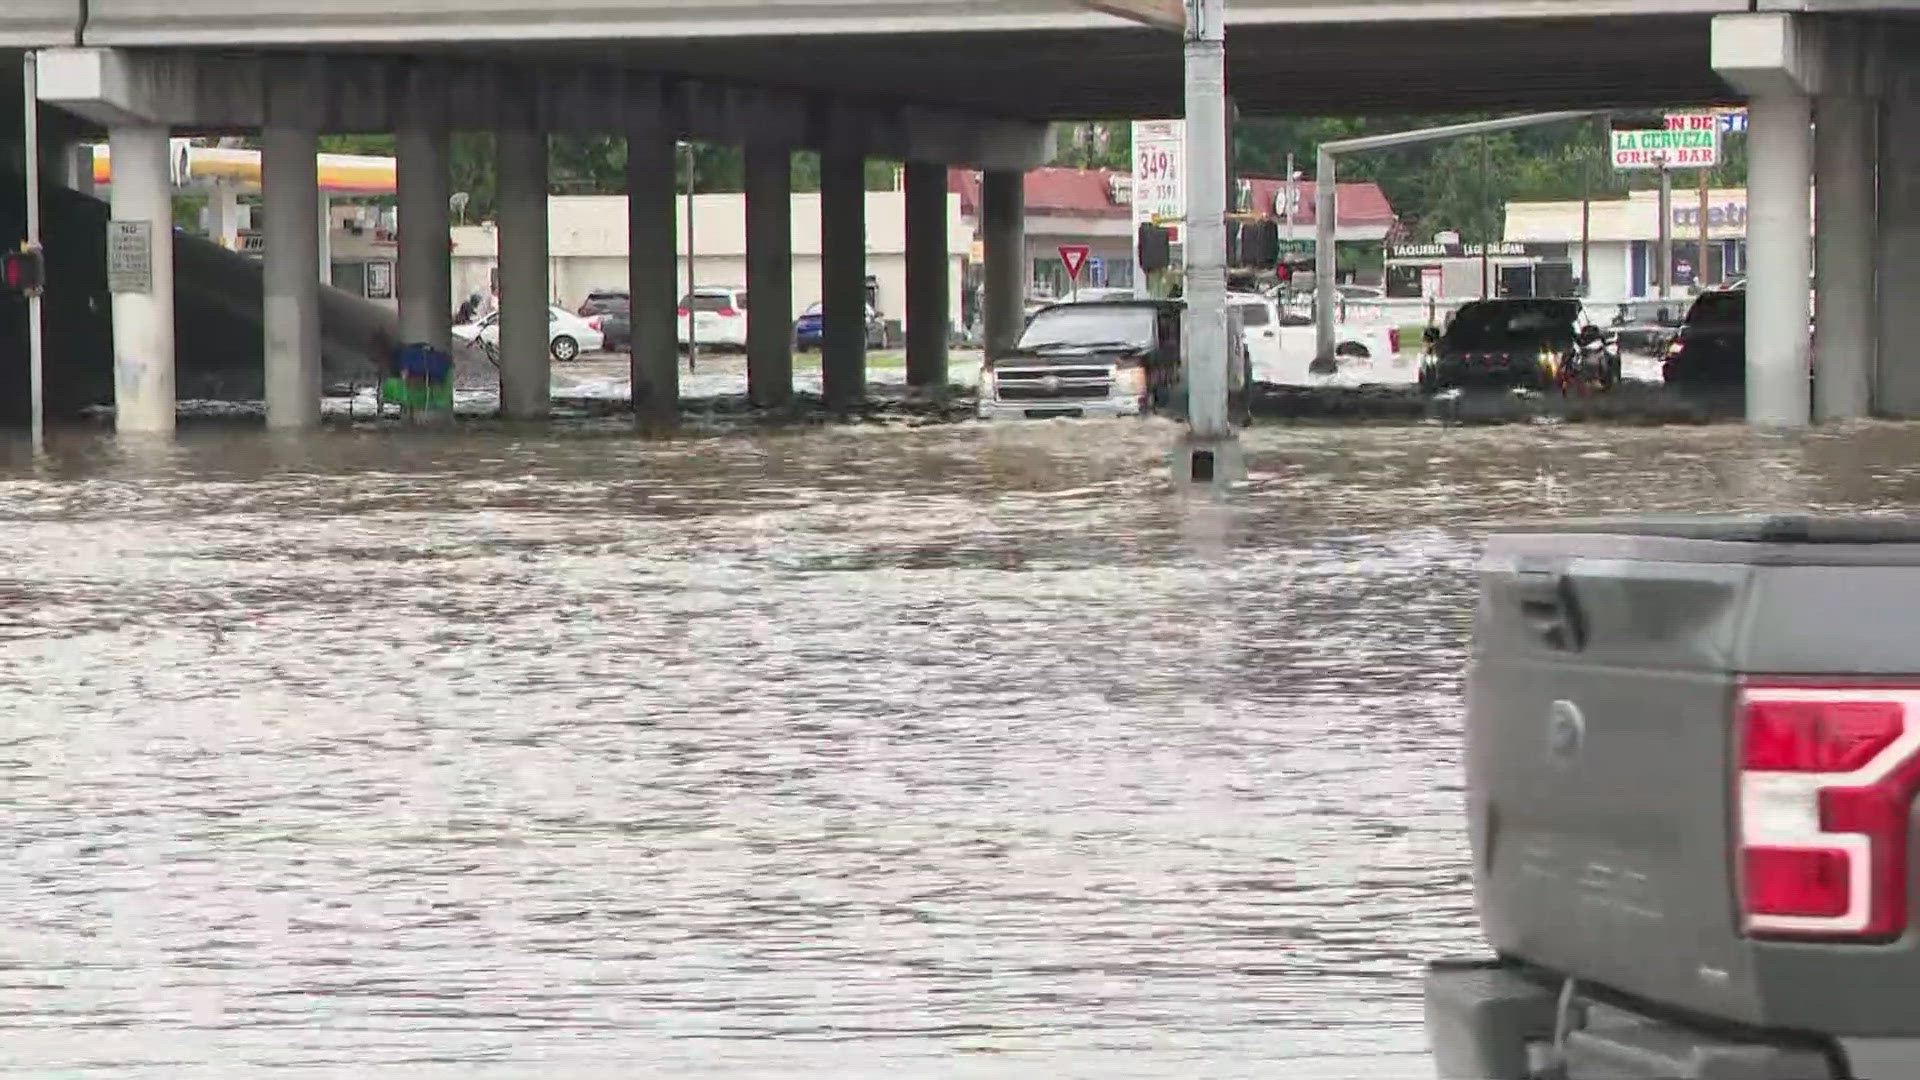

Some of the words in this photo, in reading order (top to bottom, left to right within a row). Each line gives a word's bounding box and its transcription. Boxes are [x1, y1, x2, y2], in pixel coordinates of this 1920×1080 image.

[1690, 117, 1712, 130] DE
[1617, 133, 1636, 149] LA
[1641, 132, 1712, 148] CERVEZA
[1616, 151, 1671, 163] GRILL
[1678, 149, 1712, 162] BAR
[1141, 152, 1167, 179] 349
